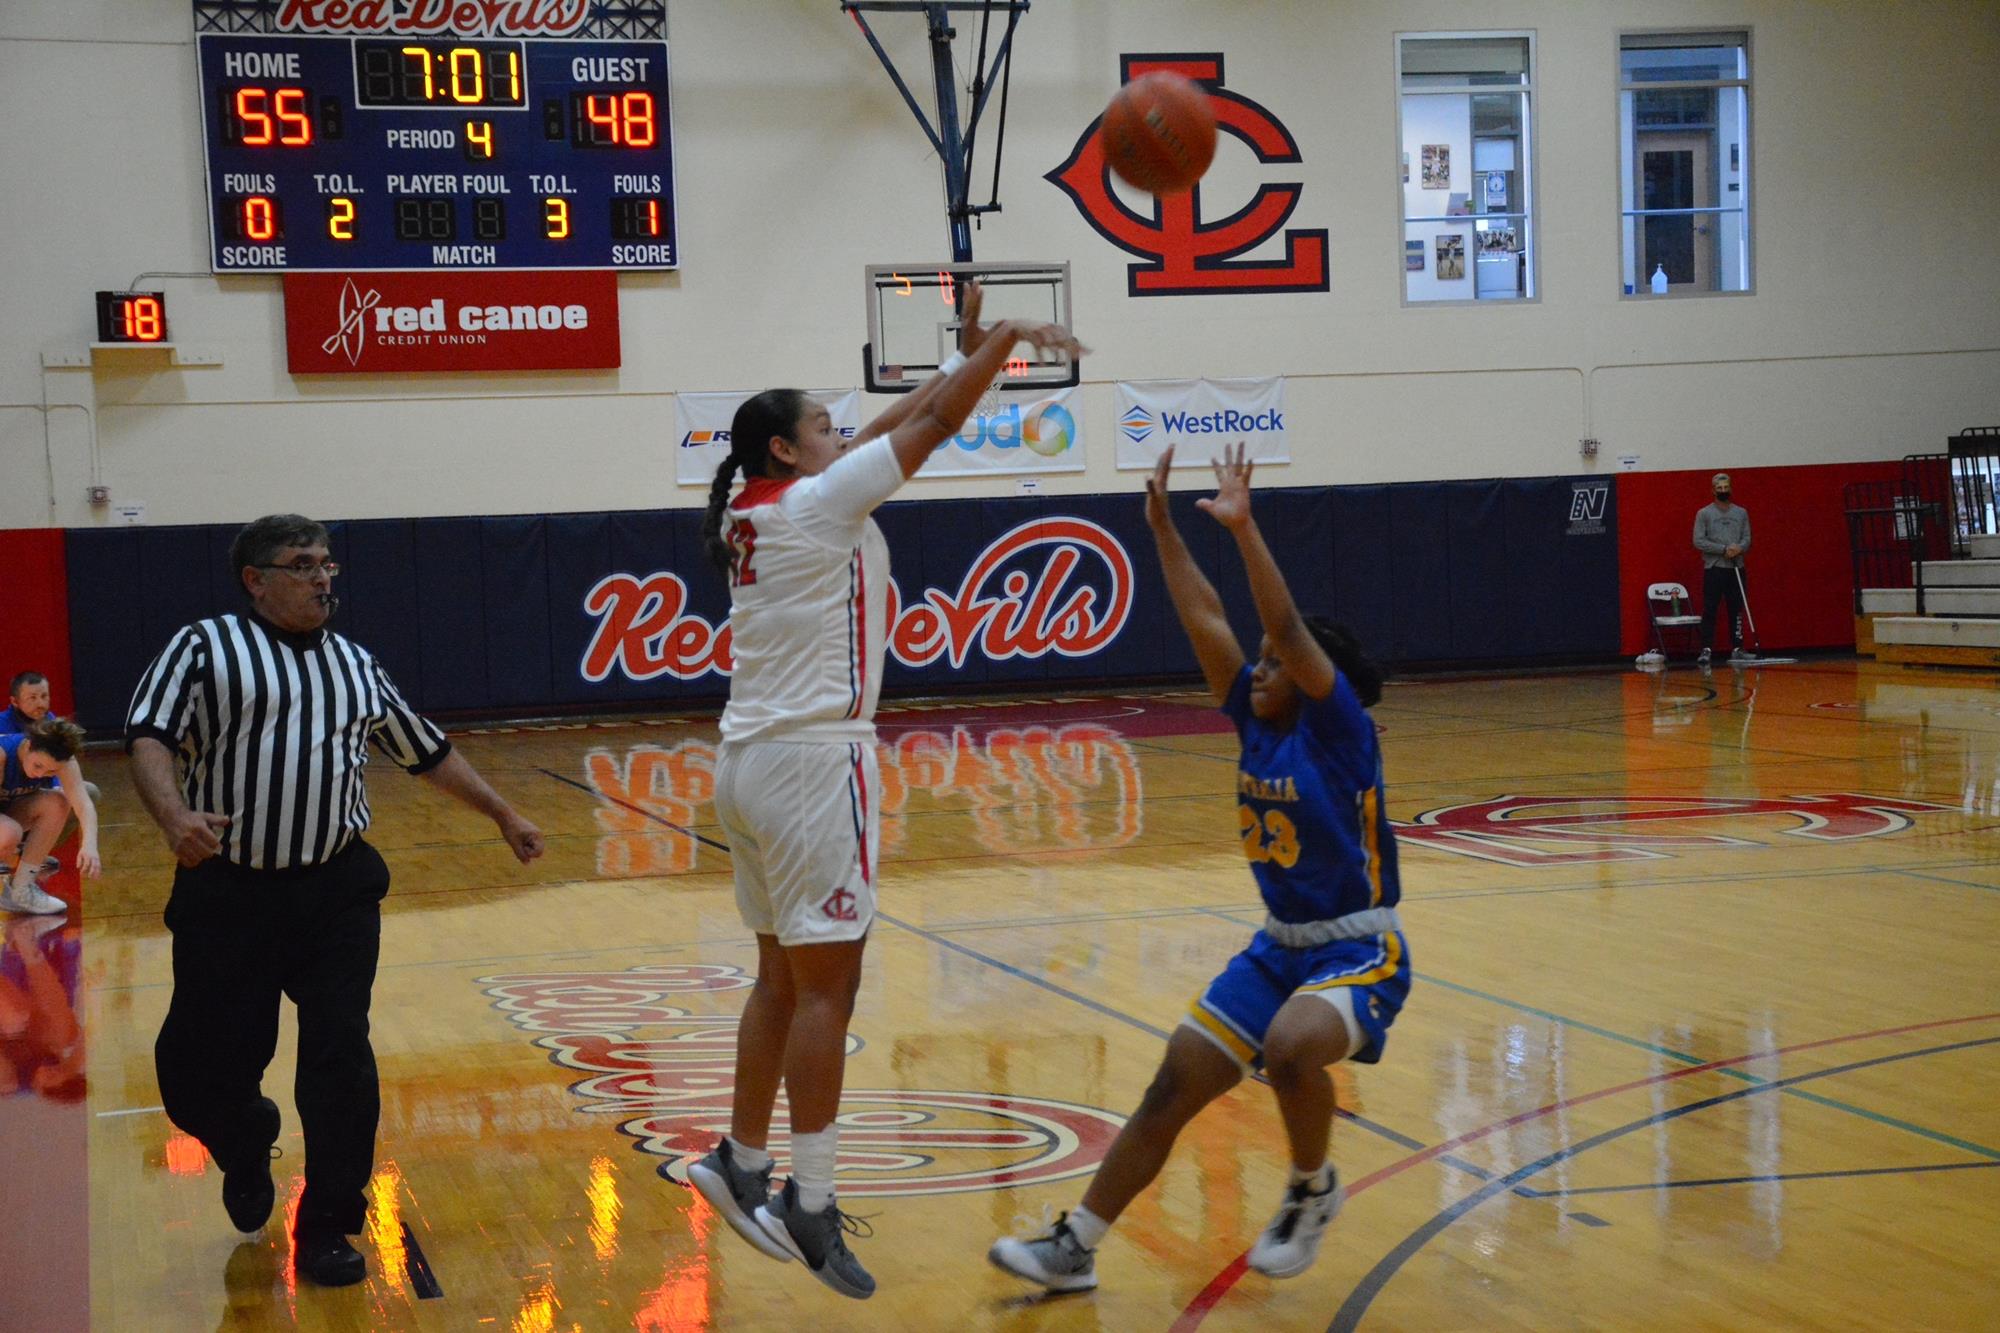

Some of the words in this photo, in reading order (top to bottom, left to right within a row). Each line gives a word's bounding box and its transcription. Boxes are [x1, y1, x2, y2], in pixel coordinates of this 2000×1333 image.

[224, 52, 301, 78] HOME
[402, 48, 518, 102] 7:01
[571, 57, 650, 83] GUEST
[237, 89, 311, 145] 55
[588, 93, 656, 146] 48
[386, 130, 456, 149] PERIOD
[467, 122, 492, 157] 4
[224, 174, 276, 194] FOULS
[314, 175, 365, 194] T.O.L.
[387, 175, 458, 195] PLAYER
[463, 175, 511, 194] FOUL
[530, 175, 577, 194] T.O.L.
[614, 175, 662, 194] FOULS
[246, 199, 272, 239] 0
[330, 199, 354, 239] 2
[546, 199, 568, 239] 3
[647, 201, 660, 236] 1
[222, 247, 287, 267] SCORE
[433, 247, 496, 265] MATCH
[612, 246, 671, 264] SCORE
[124, 298, 160, 339] 18
[375, 298, 447, 332] red
[459, 304, 588, 330] canoe
[378, 334, 432, 345] CREDIT
[439, 334, 486, 345] UNION
[1161, 408, 1284, 434] WestRock
[445, 719, 692, 737] OWER
[1240, 804, 1301, 869] 23
